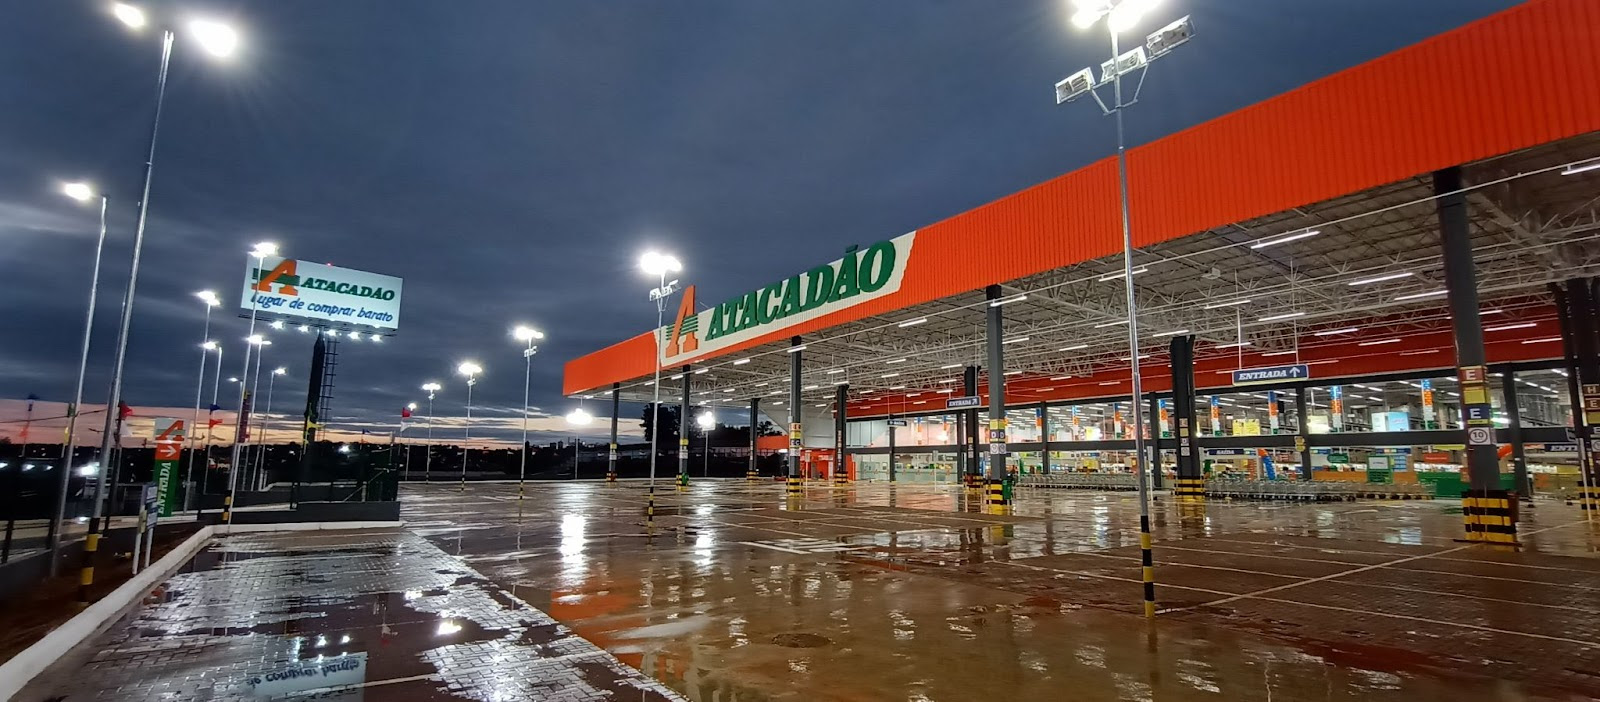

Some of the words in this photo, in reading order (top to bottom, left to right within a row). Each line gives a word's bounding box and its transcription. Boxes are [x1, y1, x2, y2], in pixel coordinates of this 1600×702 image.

[704, 240, 897, 342] ATACADÃO
[289, 298, 305, 310] de
[307, 302, 356, 316] comprar
[357, 307, 394, 322] barato
[1238, 369, 1288, 381] ENTRADA
[1465, 369, 1476, 380] E
[1587, 386, 1597, 394] H
[948, 399, 972, 407] ENTRADA
[1589, 400, 1598, 408] E
[1469, 408, 1481, 419] E
[1472, 431, 1484, 439] 10
